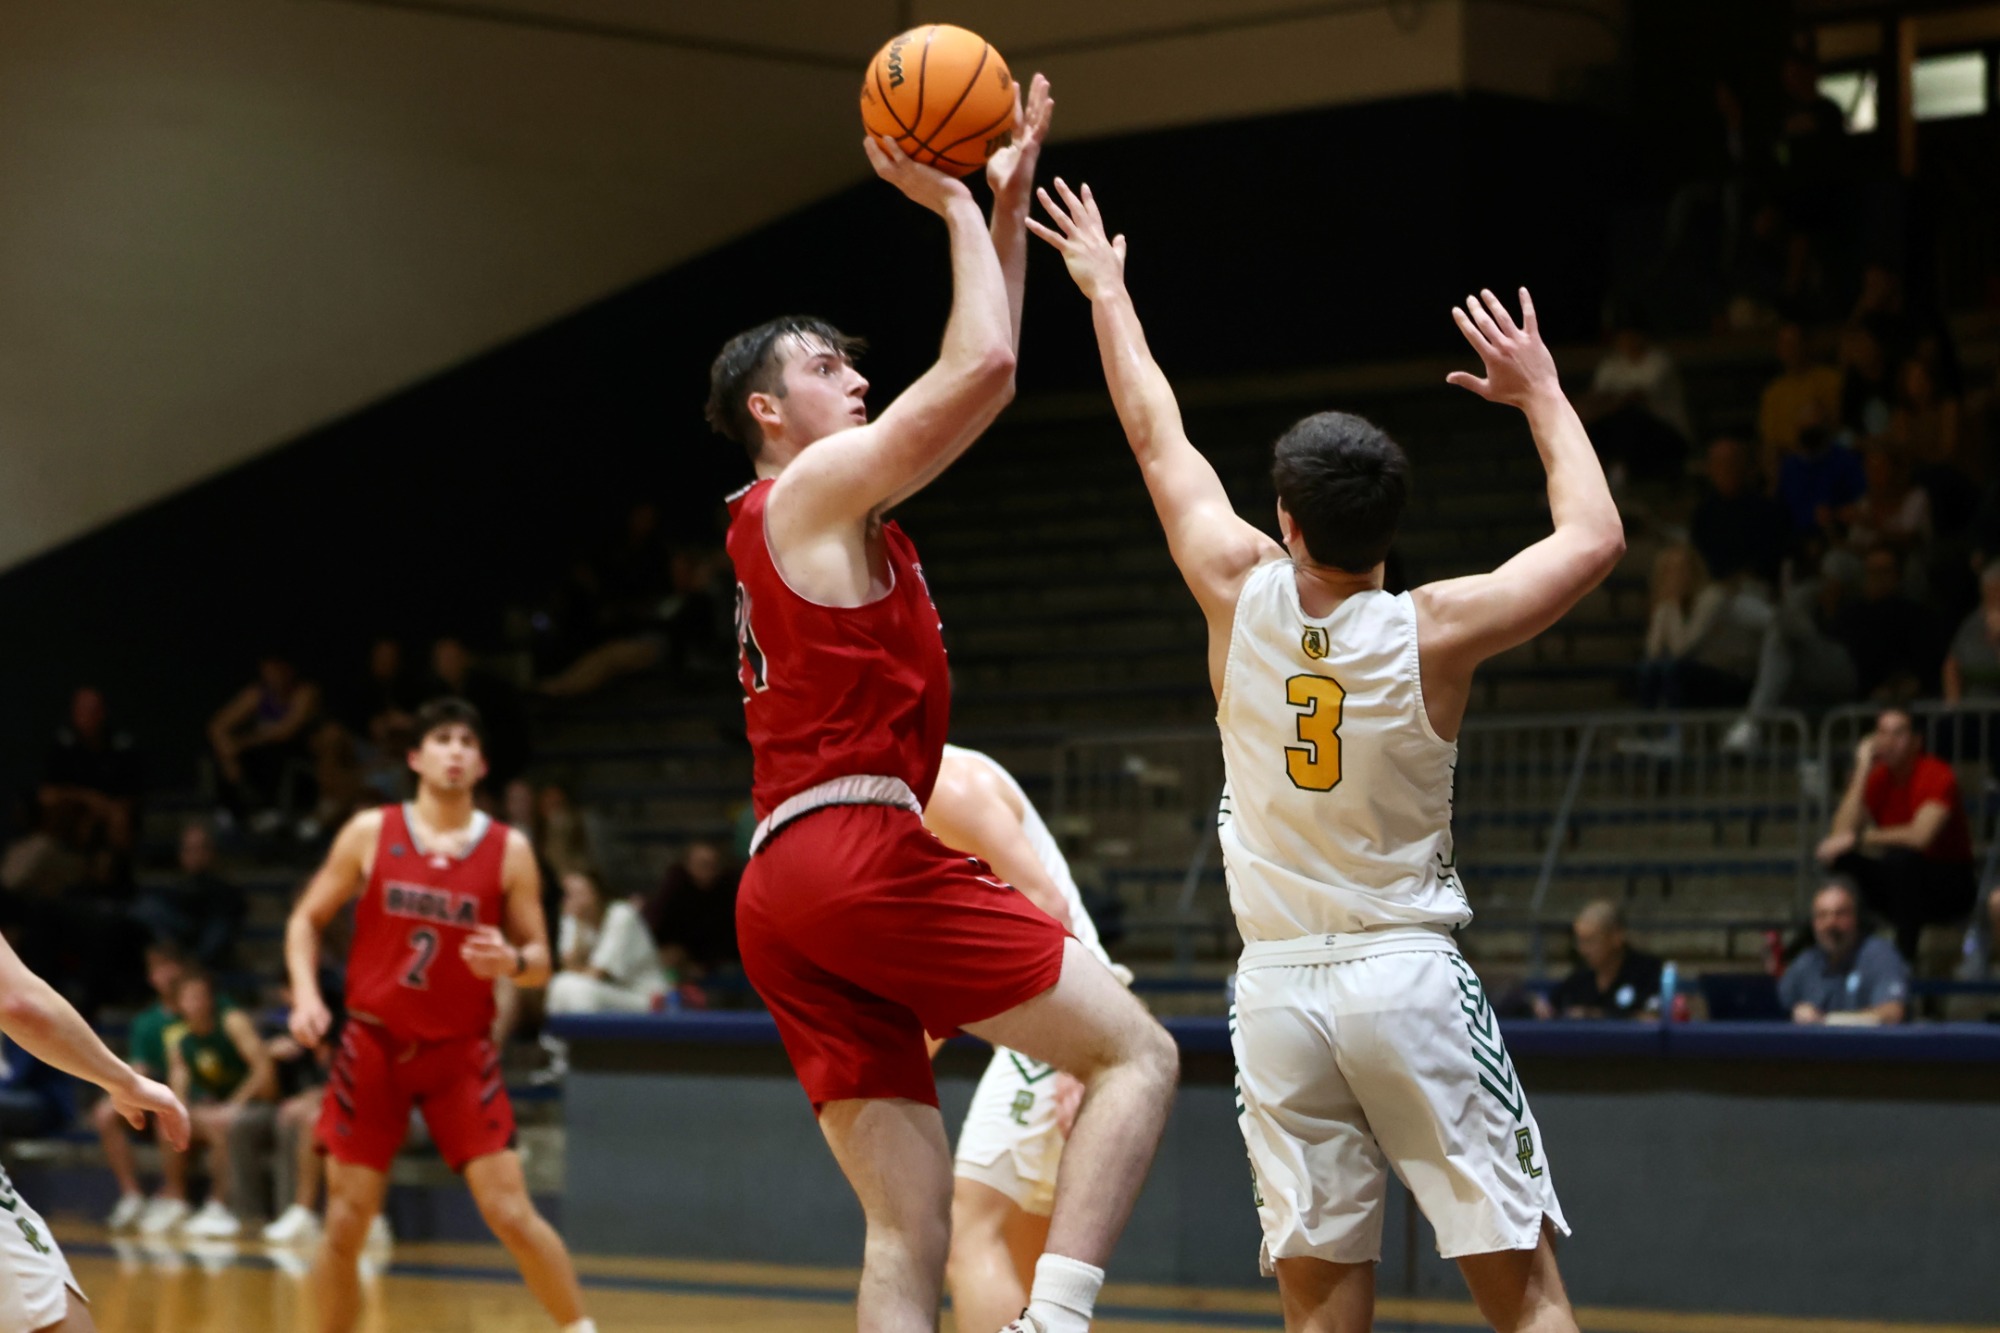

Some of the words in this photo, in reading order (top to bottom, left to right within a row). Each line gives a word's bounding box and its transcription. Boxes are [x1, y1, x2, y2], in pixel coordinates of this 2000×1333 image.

[1284, 673, 1346, 792] 3
[383, 879, 479, 930] BIOLA
[398, 926, 440, 991] 2
